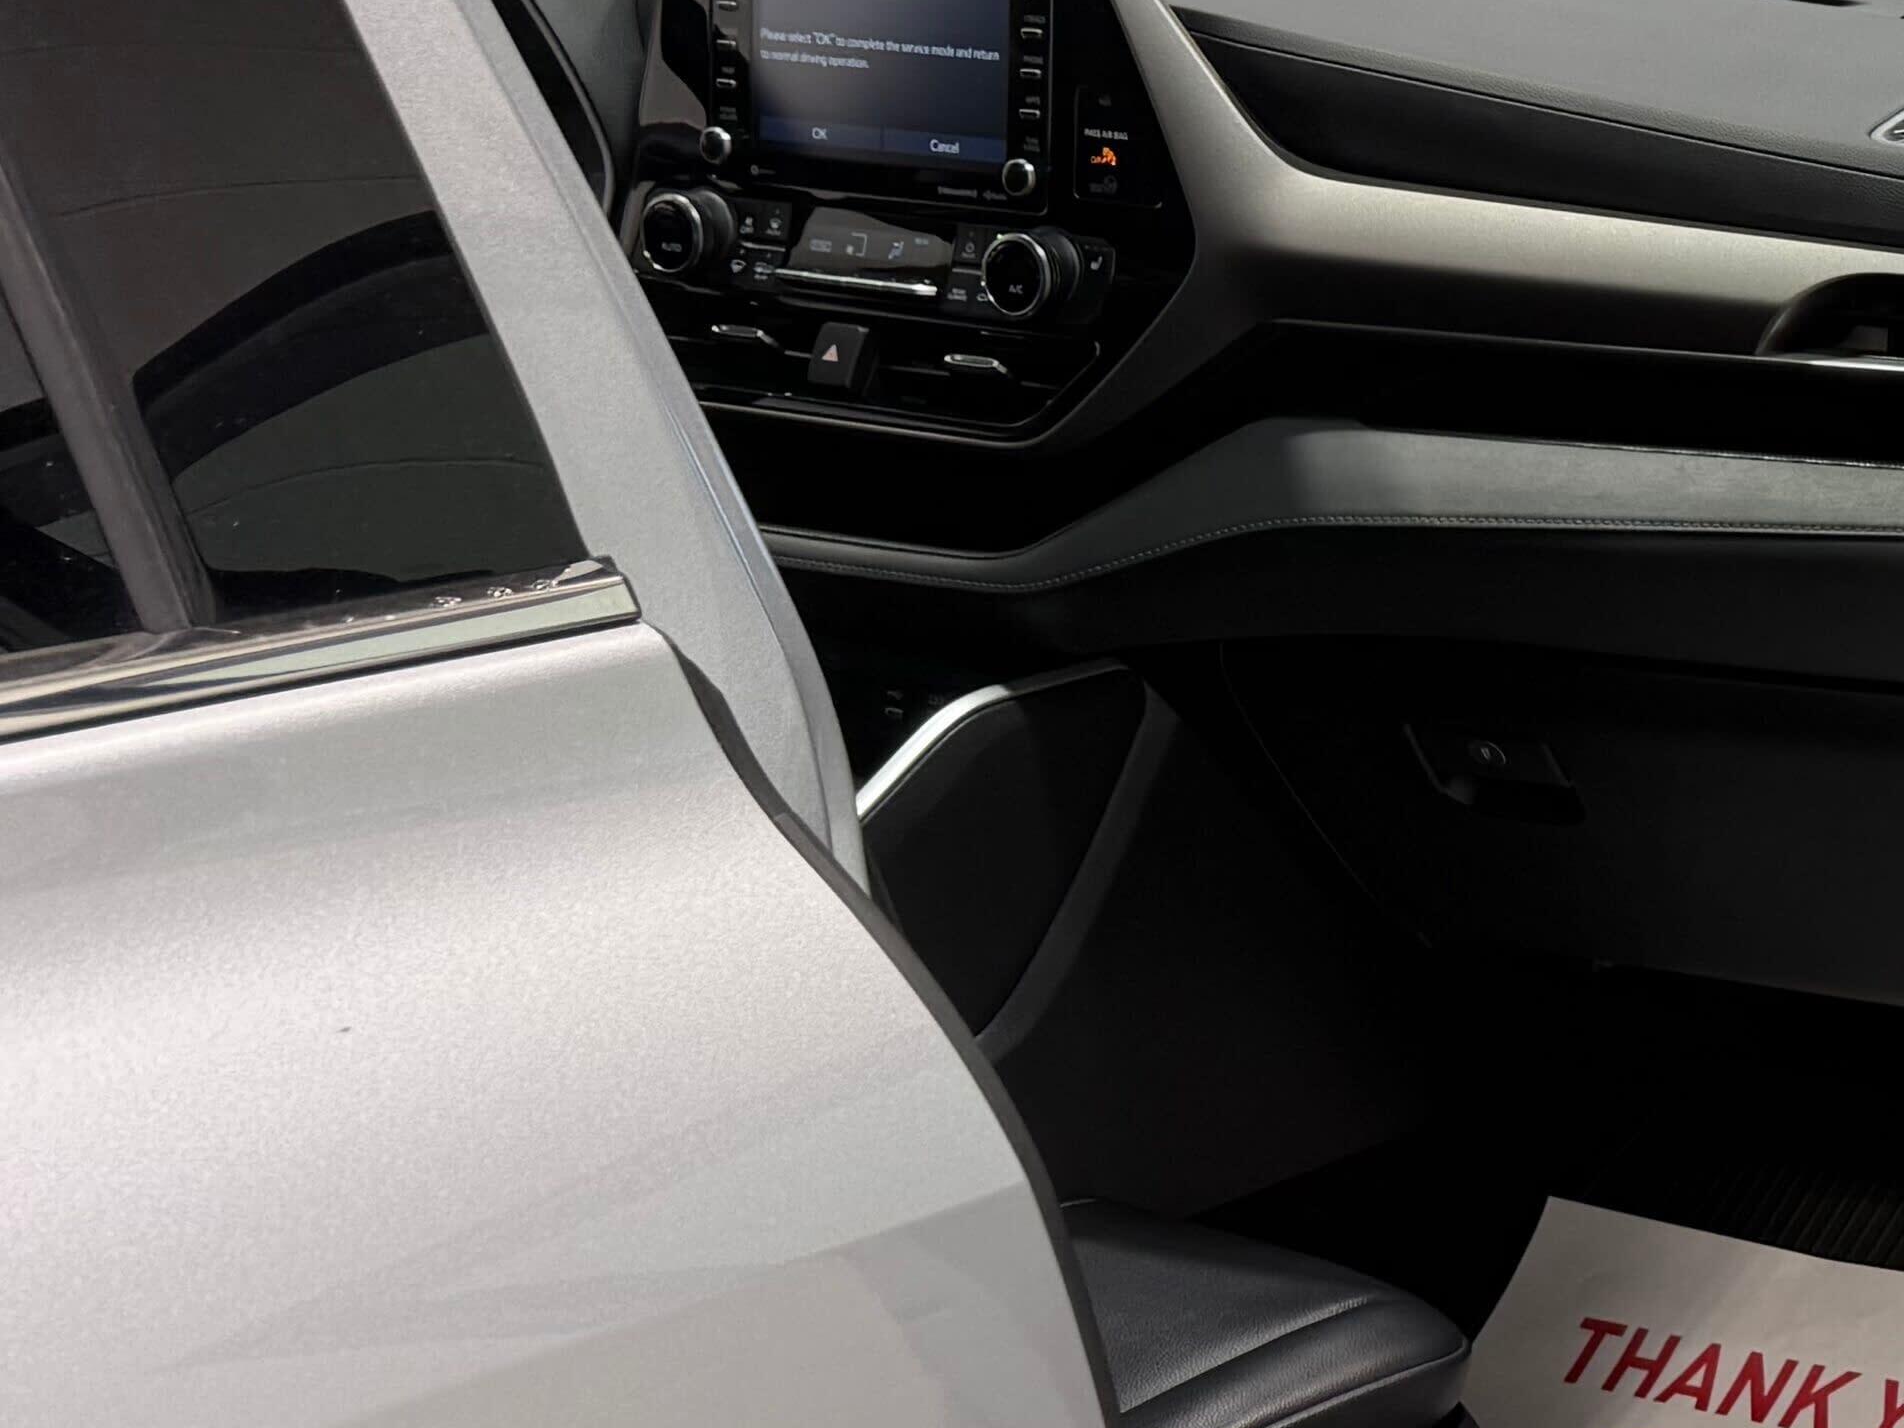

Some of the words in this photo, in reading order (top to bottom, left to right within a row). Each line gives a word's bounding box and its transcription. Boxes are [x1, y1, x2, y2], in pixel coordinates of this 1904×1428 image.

[886, 40, 900, 52] the
[811, 127, 828, 140] OK
[929, 139, 960, 154] Cancel
